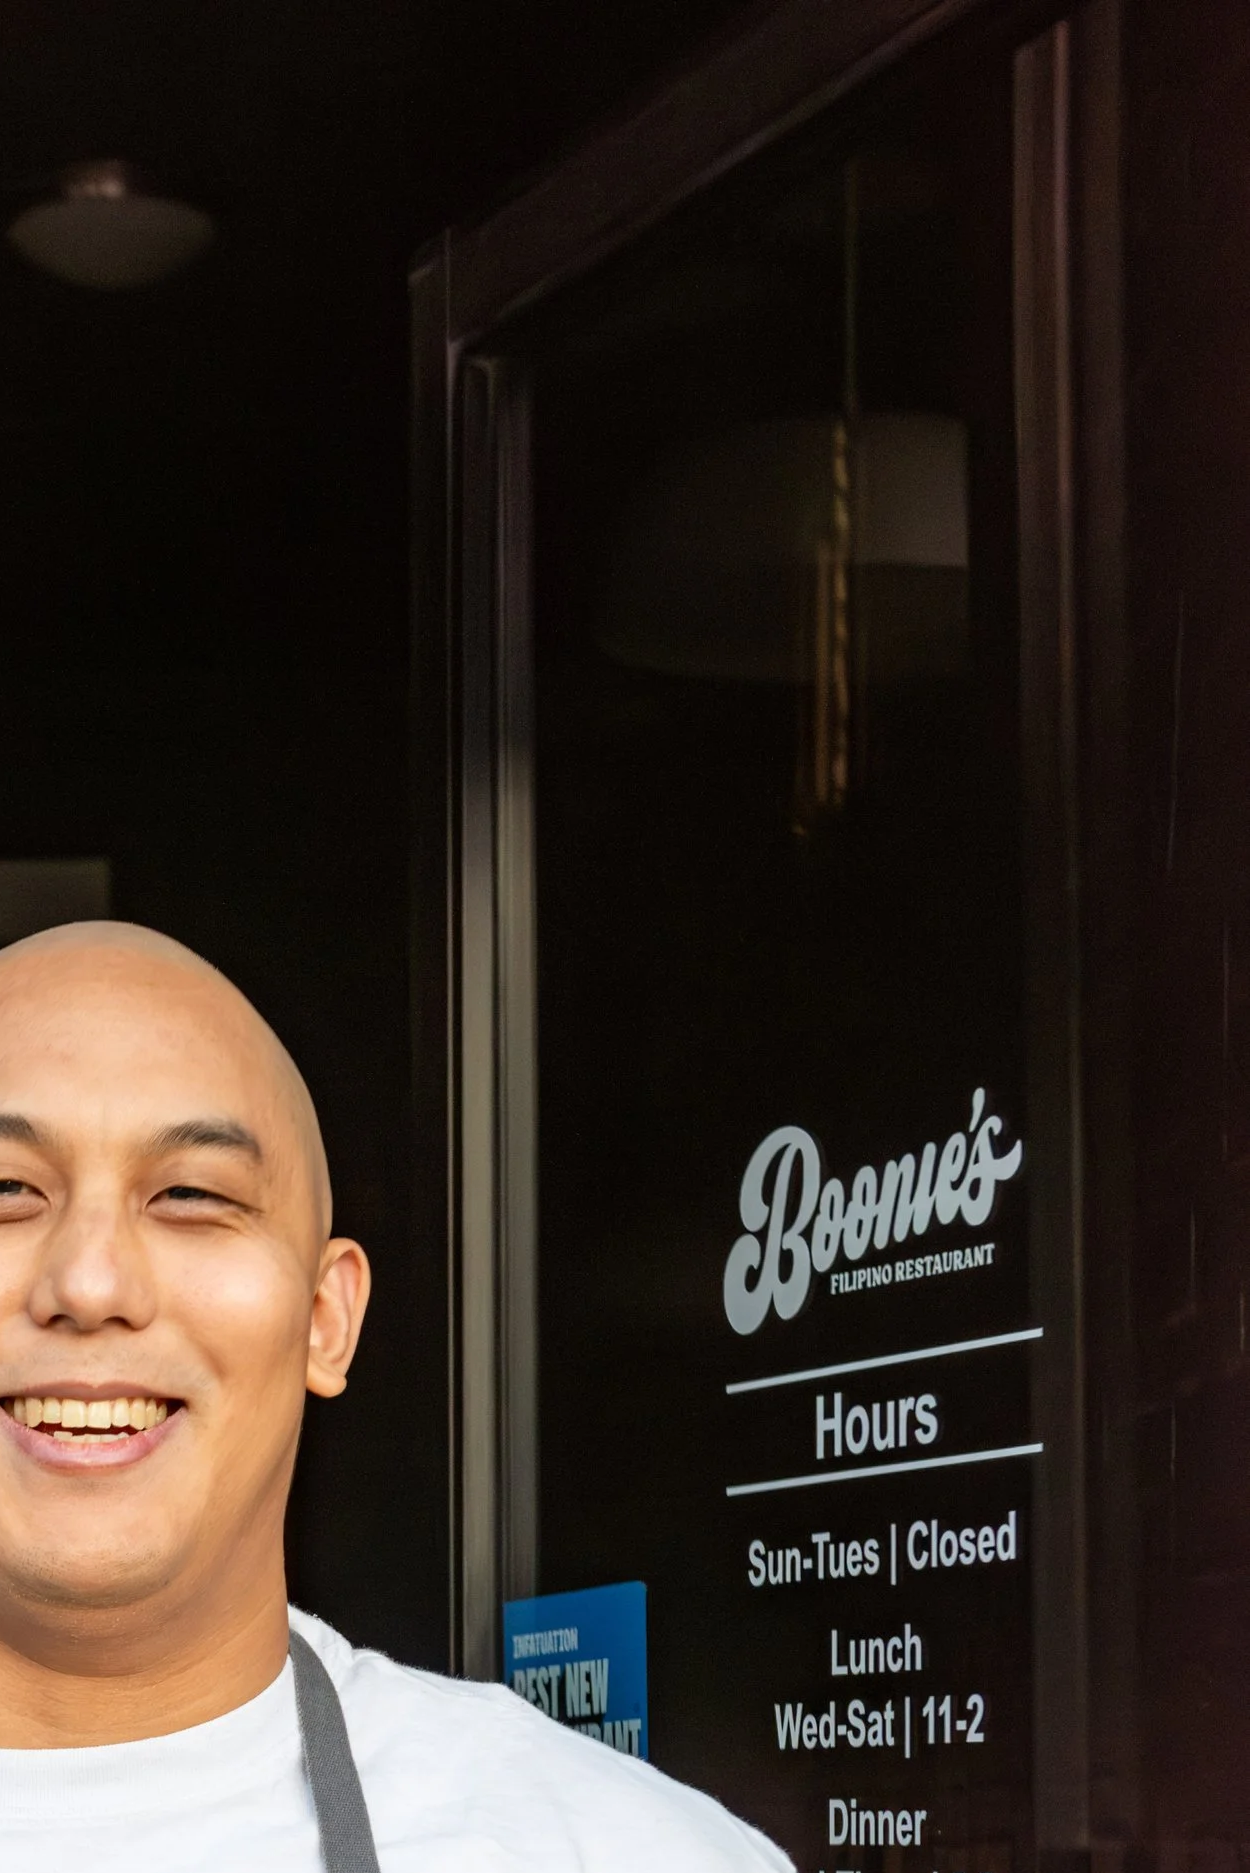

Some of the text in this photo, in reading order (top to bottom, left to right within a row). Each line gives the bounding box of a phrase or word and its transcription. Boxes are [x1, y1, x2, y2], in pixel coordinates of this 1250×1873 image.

[723, 1087, 1023, 1336] Boonie's
[830, 1242, 996, 1295] FILIPINO RESTAURANT
[815, 1391, 938, 1460] Hours
[748, 1531, 880, 1587] Sun-Tues
[907, 1510, 1017, 1570] Closed
[831, 1623, 922, 1676] Lunch
[565, 1657, 609, 1719] NEW
[774, 1699, 895, 1750] Wed-Sat
[922, 1693, 985, 1745] 11-2
[828, 1798, 928, 1847] Dinner
